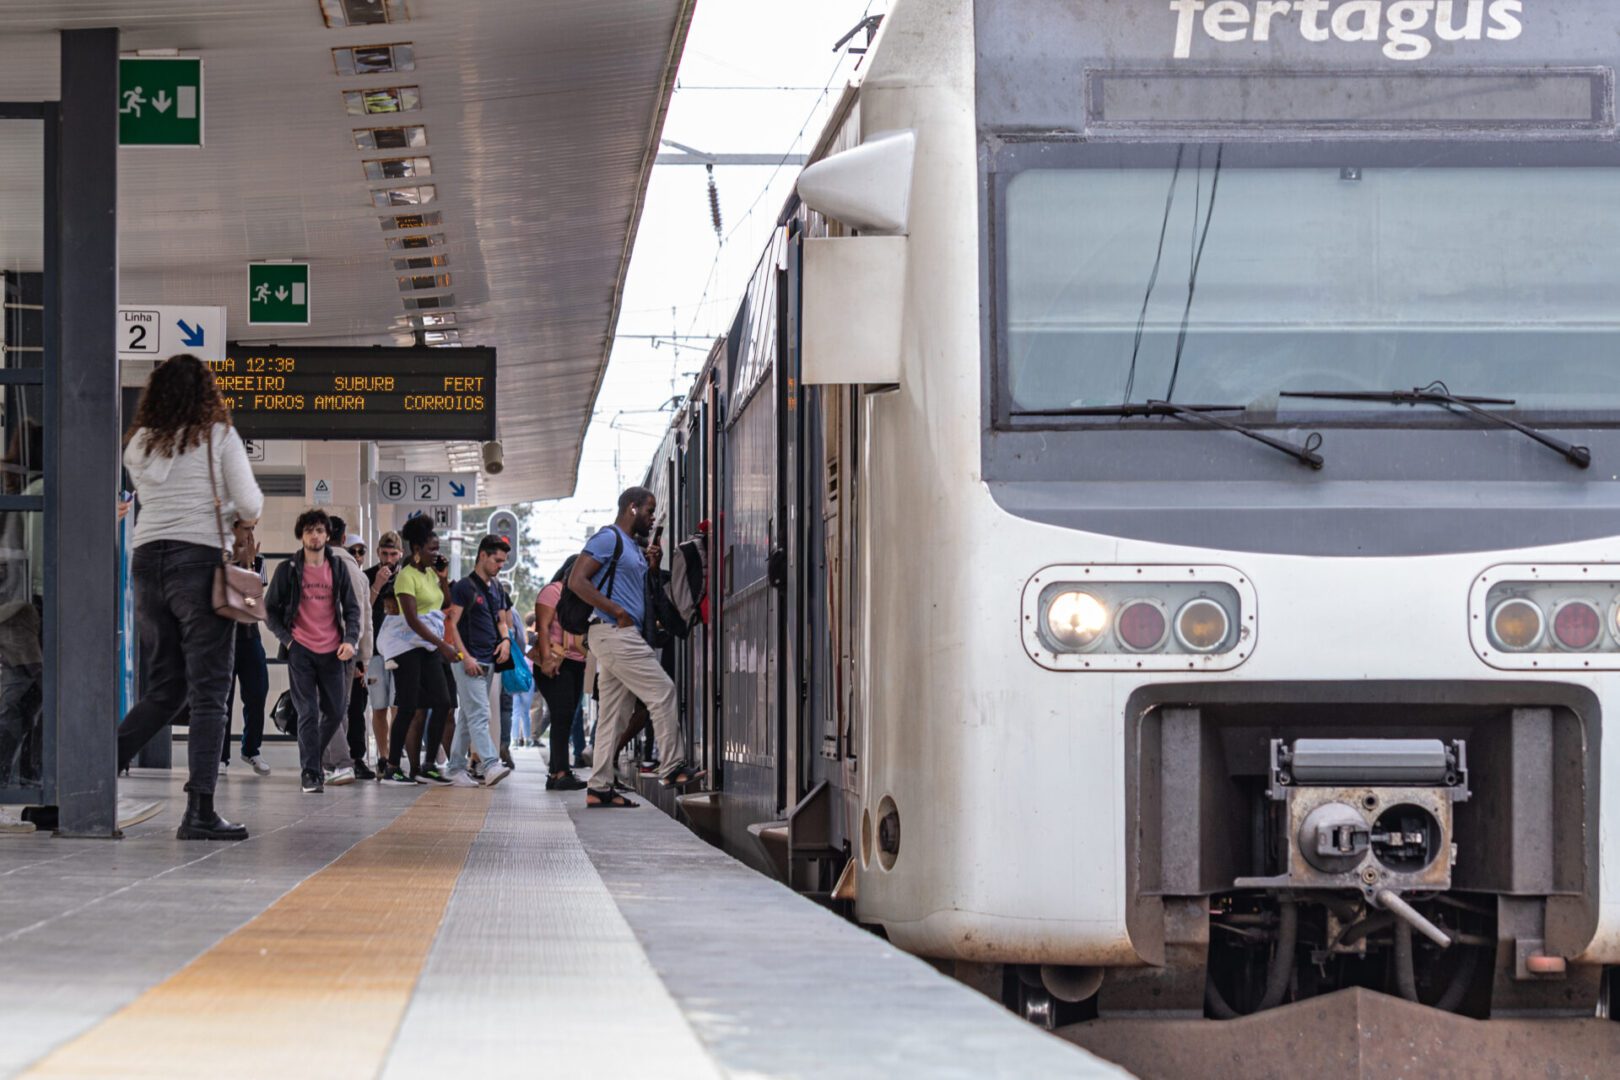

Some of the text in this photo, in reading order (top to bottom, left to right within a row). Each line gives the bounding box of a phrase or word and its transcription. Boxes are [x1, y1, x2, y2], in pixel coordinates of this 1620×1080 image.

[1169, 0, 1523, 61] fertagus
[125, 312, 152, 322] Linha
[129, 324, 147, 350] 2
[208, 357, 295, 372] IDA 12:38
[215, 376, 484, 392] AREEIRO SUBURB FERT
[254, 394, 305, 410] FOROS
[314, 394, 366, 410] AMORA
[404, 395, 485, 411] CORROIOS
[389, 480, 402, 496] B
[420, 483, 432, 499] 2
